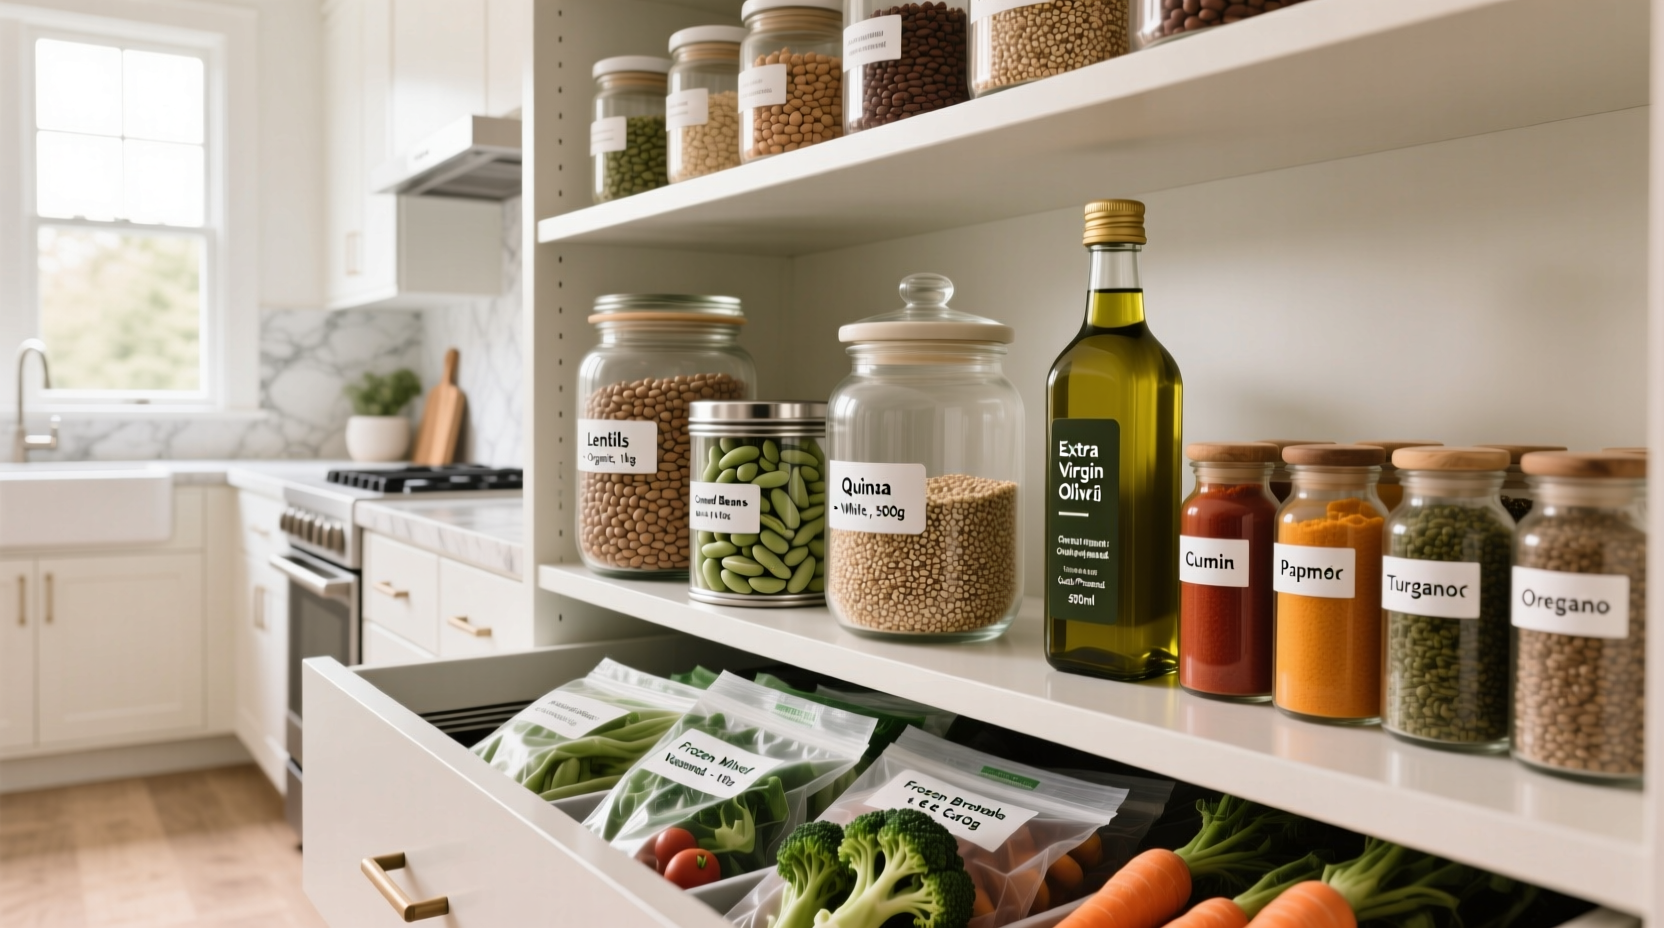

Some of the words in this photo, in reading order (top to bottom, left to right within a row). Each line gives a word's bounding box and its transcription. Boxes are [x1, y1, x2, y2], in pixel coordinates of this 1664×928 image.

[587, 431, 629, 448] Lentils
[1059, 440, 1099, 458] Extra
[1058, 461, 1104, 484] Virgin
[875, 505, 906, 522] 500g
[1185, 551, 1235, 571] Cumin
[1522, 588, 1612, 617] Oregano
[678, 741, 717, 764] Frozen
[904, 780, 948, 802] Frozen
